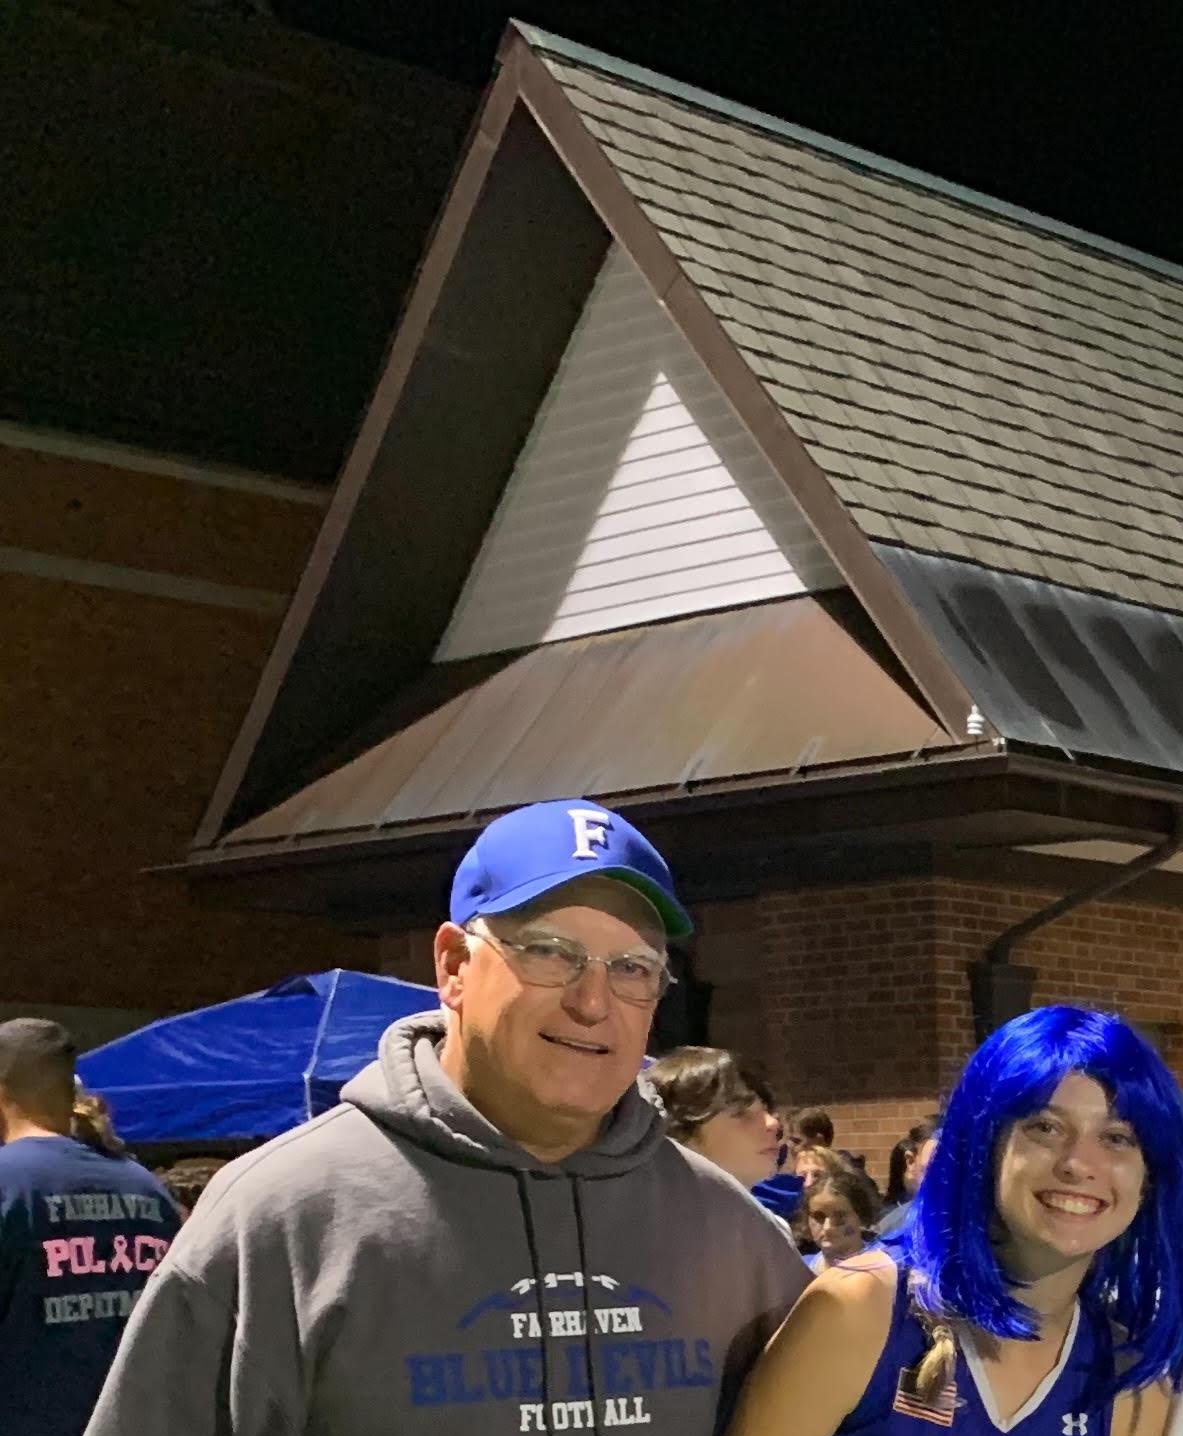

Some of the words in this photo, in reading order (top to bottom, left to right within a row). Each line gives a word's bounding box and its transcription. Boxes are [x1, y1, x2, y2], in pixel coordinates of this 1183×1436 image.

[567, 808, 611, 859] F
[511, 1306, 643, 1339] FARHVEN
[405, 1347, 546, 1407] BLUE
